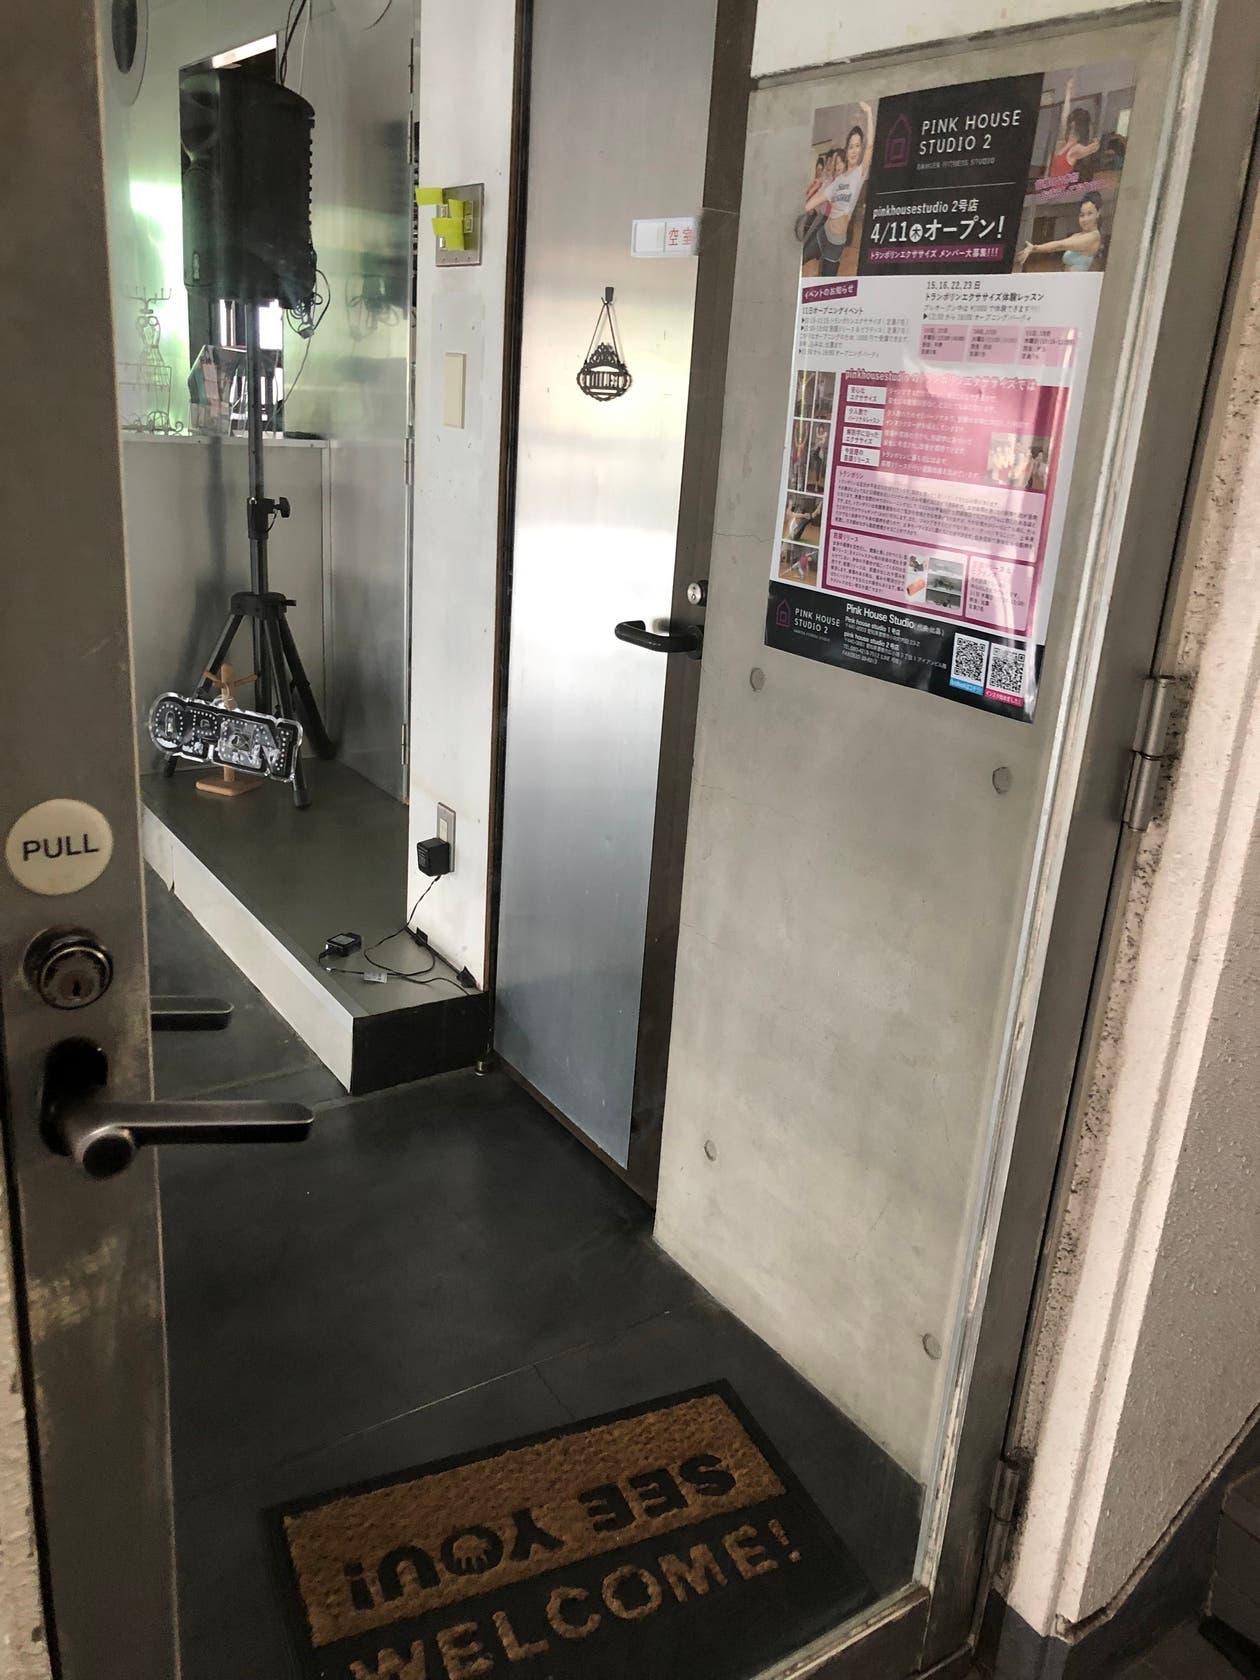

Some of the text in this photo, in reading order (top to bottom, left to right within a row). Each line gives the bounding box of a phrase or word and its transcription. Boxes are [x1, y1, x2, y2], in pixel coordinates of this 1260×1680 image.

[921, 110, 1022, 136] PINK HOUSE
[919, 134, 992, 155] STUDIO 2
[873, 199, 979, 219] pinkhousestudio 2号店
[668, 226, 695, 246] 空室
[794, 607, 841, 627] PINK HOUSE
[794, 617, 829, 634] STUDIO 2
[846, 603, 862, 616] Pink
[863, 608, 888, 622] House
[889, 613, 914, 630] Studio
[23, 833, 100, 862] PULL
[342, 1454, 737, 1611] SEE YOU!
[349, 1518, 801, 1680] WELCOME!
